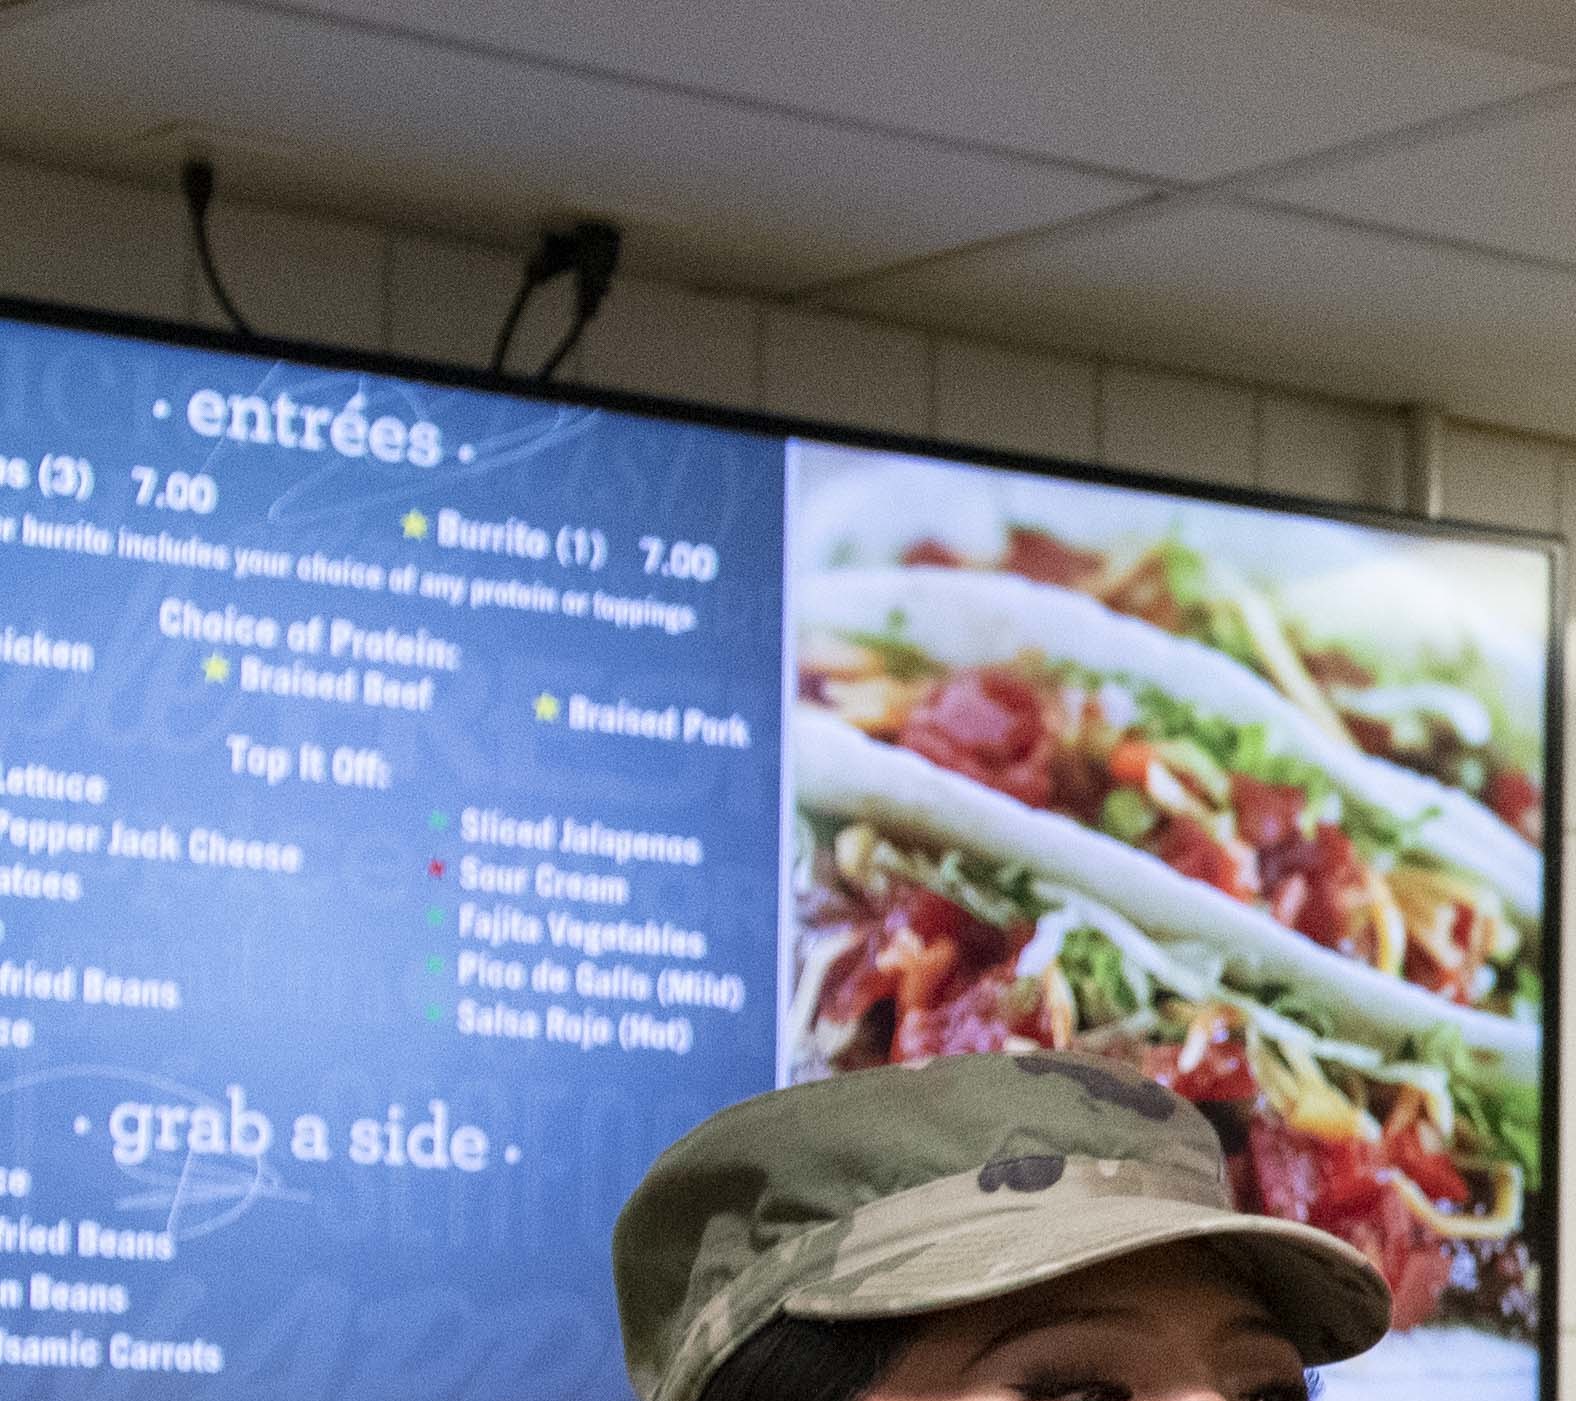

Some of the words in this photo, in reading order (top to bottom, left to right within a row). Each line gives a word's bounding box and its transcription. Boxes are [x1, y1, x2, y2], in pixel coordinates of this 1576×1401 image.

[187, 388, 442, 467] entrées
[38, 453, 94, 501] (3)
[131, 465, 217, 514] 7.00
[437, 508, 550, 560] Burrito
[556, 525, 607, 571] (1)
[640, 535, 718, 582] 7.00
[22, 512, 114, 556] burrito
[118, 526, 231, 571] includes
[234, 549, 292, 579] your
[296, 552, 385, 591] choice
[388, 564, 418, 595] of
[420, 571, 466, 607] any
[470, 577, 558, 613] protein
[562, 590, 589, 617] or
[593, 590, 698, 635] toppings
[0, 625, 95, 673] icken
[160, 598, 278, 650] Choice
[287, 615, 324, 655] of
[240, 655, 359, 703] Braised
[363, 669, 434, 713] Beef
[568, 694, 681, 742] Braised
[684, 707, 750, 749] Pork
[0, 757, 107, 805] ettuce
[226, 734, 292, 786] Top
[107, 819, 181, 862] Jack
[189, 827, 303, 874] Cheese
[460, 806, 556, 850] Sliced
[460, 855, 529, 894] Sour
[535, 862, 629, 904] Cream
[459, 902, 544, 948] Fajita
[548, 911, 706, 960] Vegetables
[83, 966, 182, 1010] Beans
[457, 949, 527, 991] Pico
[531, 958, 570, 994] de
[575, 961, 651, 1001] Gallo
[656, 967, 746, 1014] (Mild)
[457, 999, 541, 1040] Salsa
[109, 1083, 275, 1167] grab
[291, 1113, 330, 1162] a
[349, 1099, 489, 1172] side
[78, 1218, 177, 1262] Beans
[30, 1272, 131, 1315] Beans
[108, 1331, 225, 1374] Carrots
